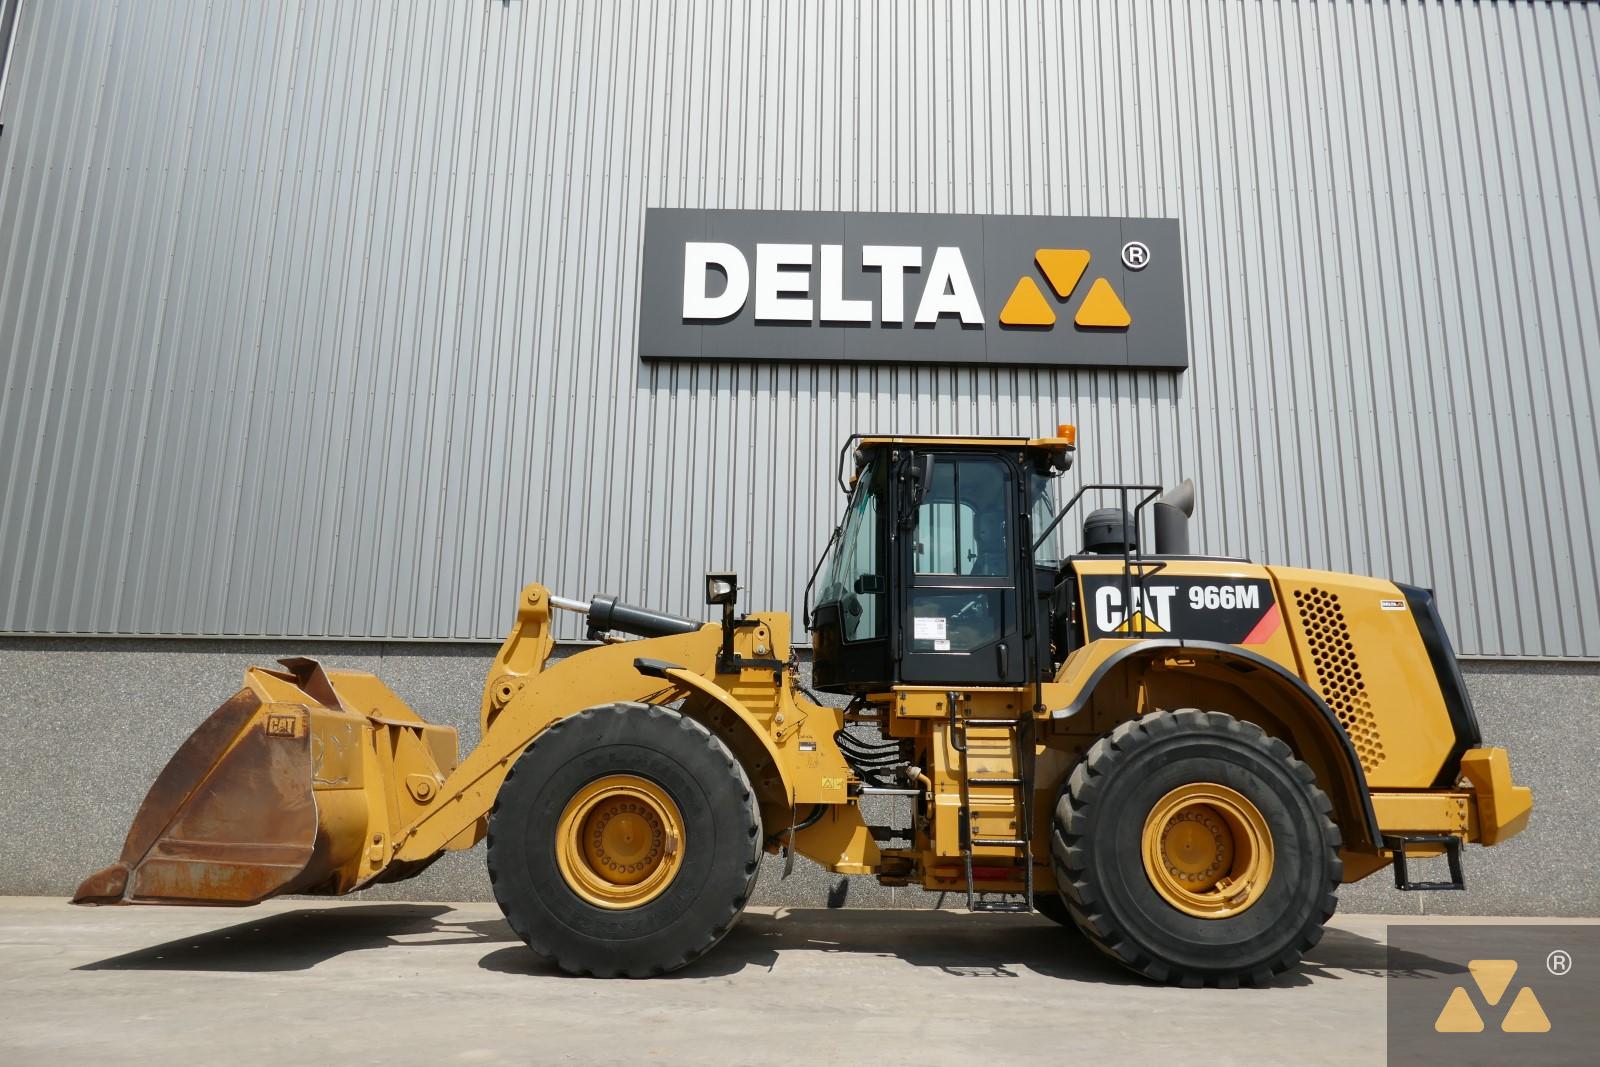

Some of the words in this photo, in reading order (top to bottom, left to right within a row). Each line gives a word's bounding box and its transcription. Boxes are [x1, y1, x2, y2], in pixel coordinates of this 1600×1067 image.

[682, 241, 985, 324] DELTA
[1095, 585, 1176, 632] CAT
[1188, 585, 1260, 610] 966M
[269, 717, 295, 734] CAT
